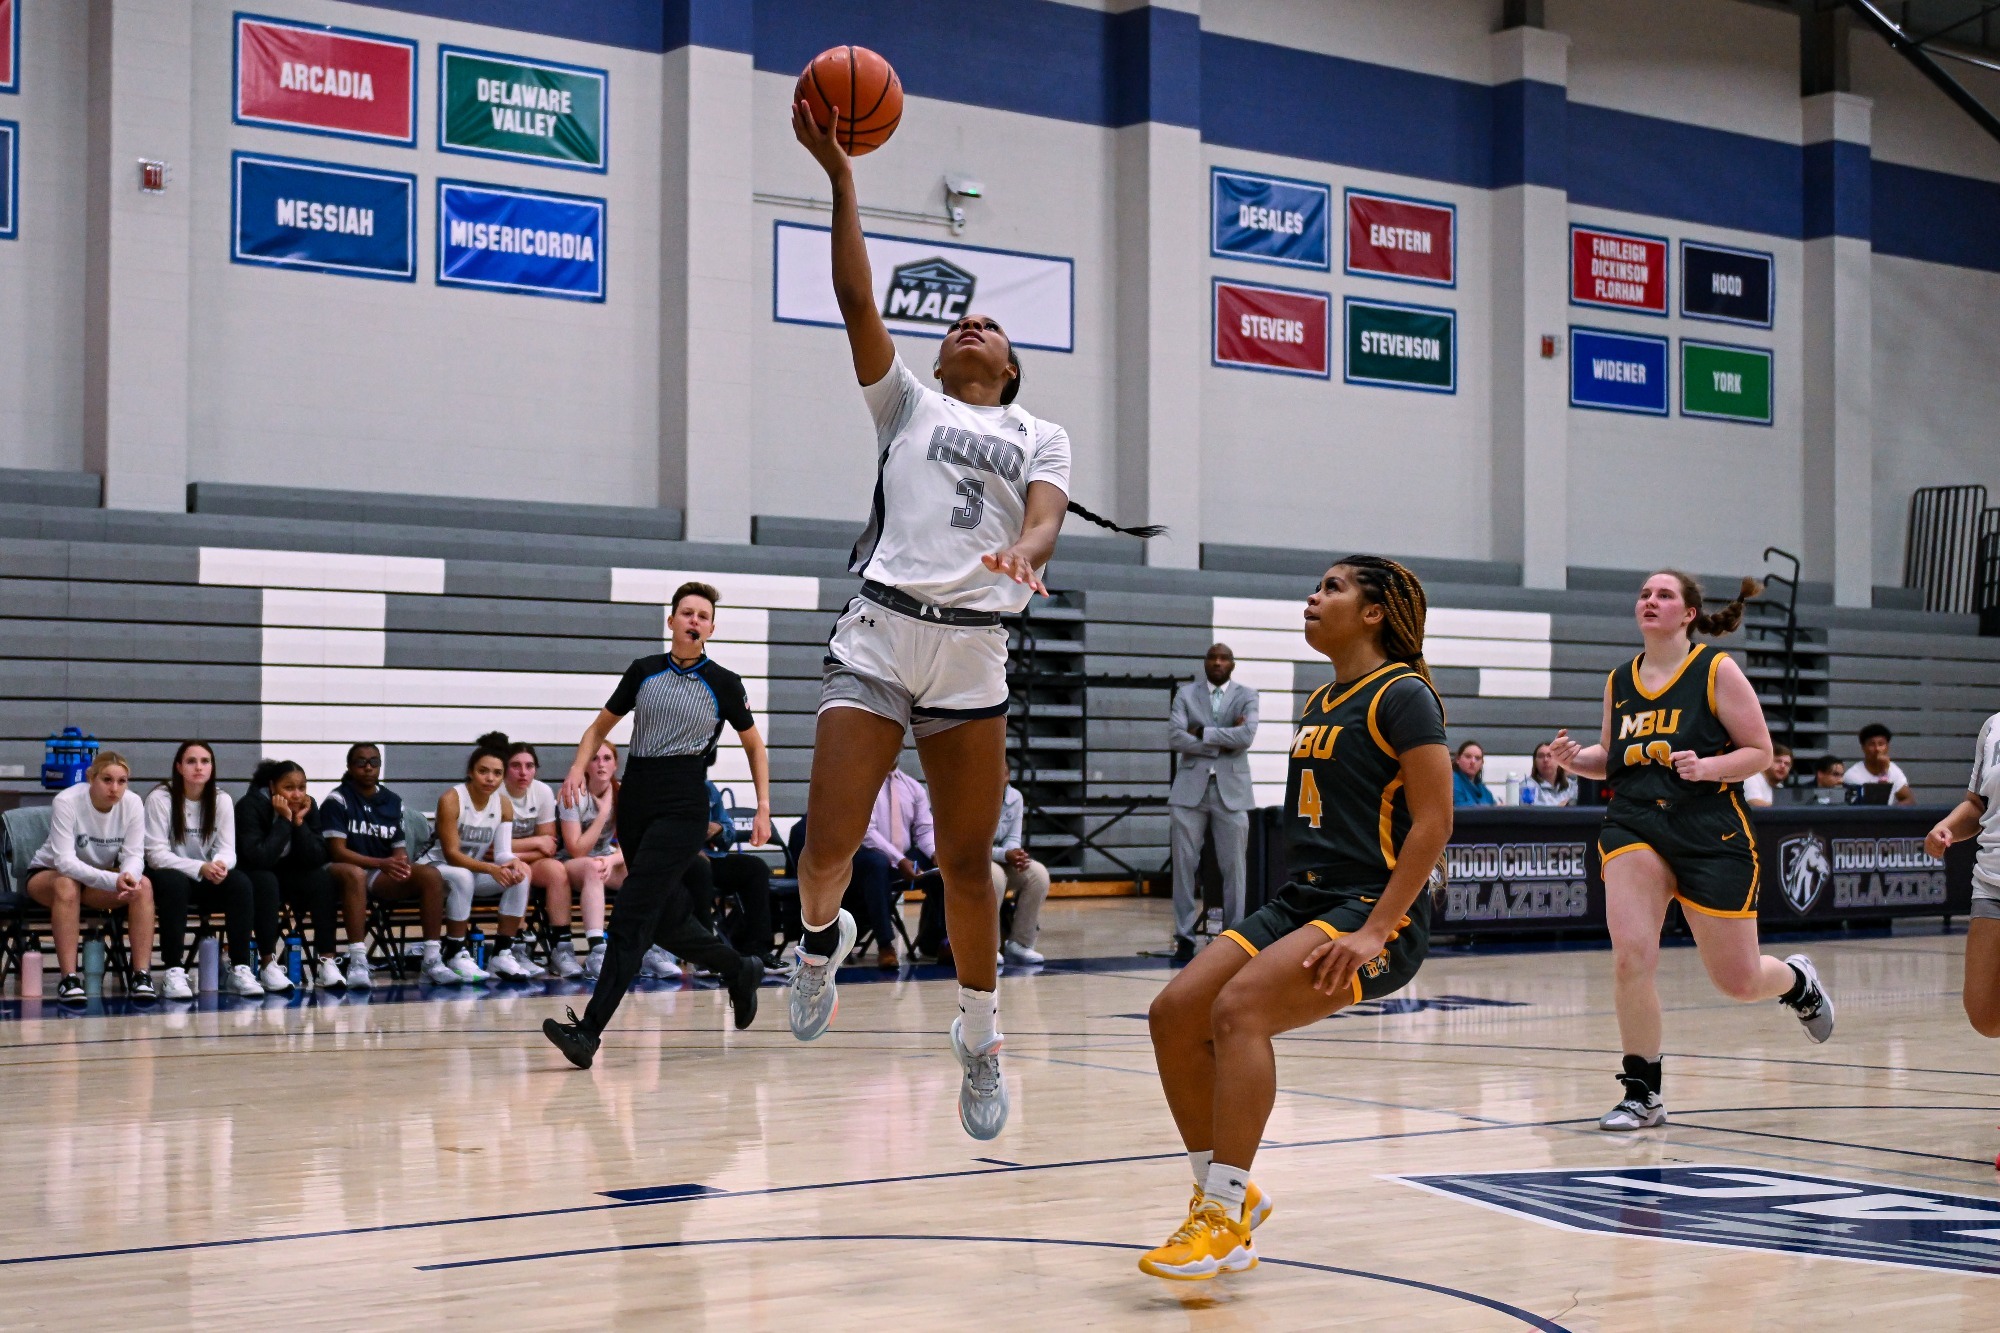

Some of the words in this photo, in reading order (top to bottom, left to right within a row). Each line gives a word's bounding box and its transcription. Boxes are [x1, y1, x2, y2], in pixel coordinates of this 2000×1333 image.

[279, 60, 374, 102] ARCADIA
[476, 77, 572, 114] DELAWARE
[491, 106, 557, 138] VALLEY
[276, 198, 374, 237] MESSIAH
[1238, 203, 1305, 235] DESALES
[450, 219, 595, 262] MISERICORDIA
[1370, 223, 1433, 255] EASTERN
[1592, 237, 1648, 263] FAIRLEIGH
[1591, 257, 1649, 284] DICKINSON
[1711, 272, 1743, 297] HOOD
[889, 288, 968, 321] MAC
[1595, 278, 1645, 303] FLORHAM
[1240, 313, 1305, 345] STEVENS
[1360, 330, 1441, 362] STEVENSON
[1592, 357, 1648, 385] WIDENER
[1712, 370, 1743, 395] YORK
[927, 425, 1025, 482] HOOD
[950, 478, 985, 530] 3
[1618, 708, 1683, 740] MBU
[1298, 768, 1323, 829] 4
[1446, 843, 1500, 881] HOOD
[1500, 842, 1586, 881] COLLEGE
[1832, 838, 1876, 873] HOOD
[1445, 881, 1588, 921] BLAZERS
[1833, 871, 1947, 908] BLAZERS
